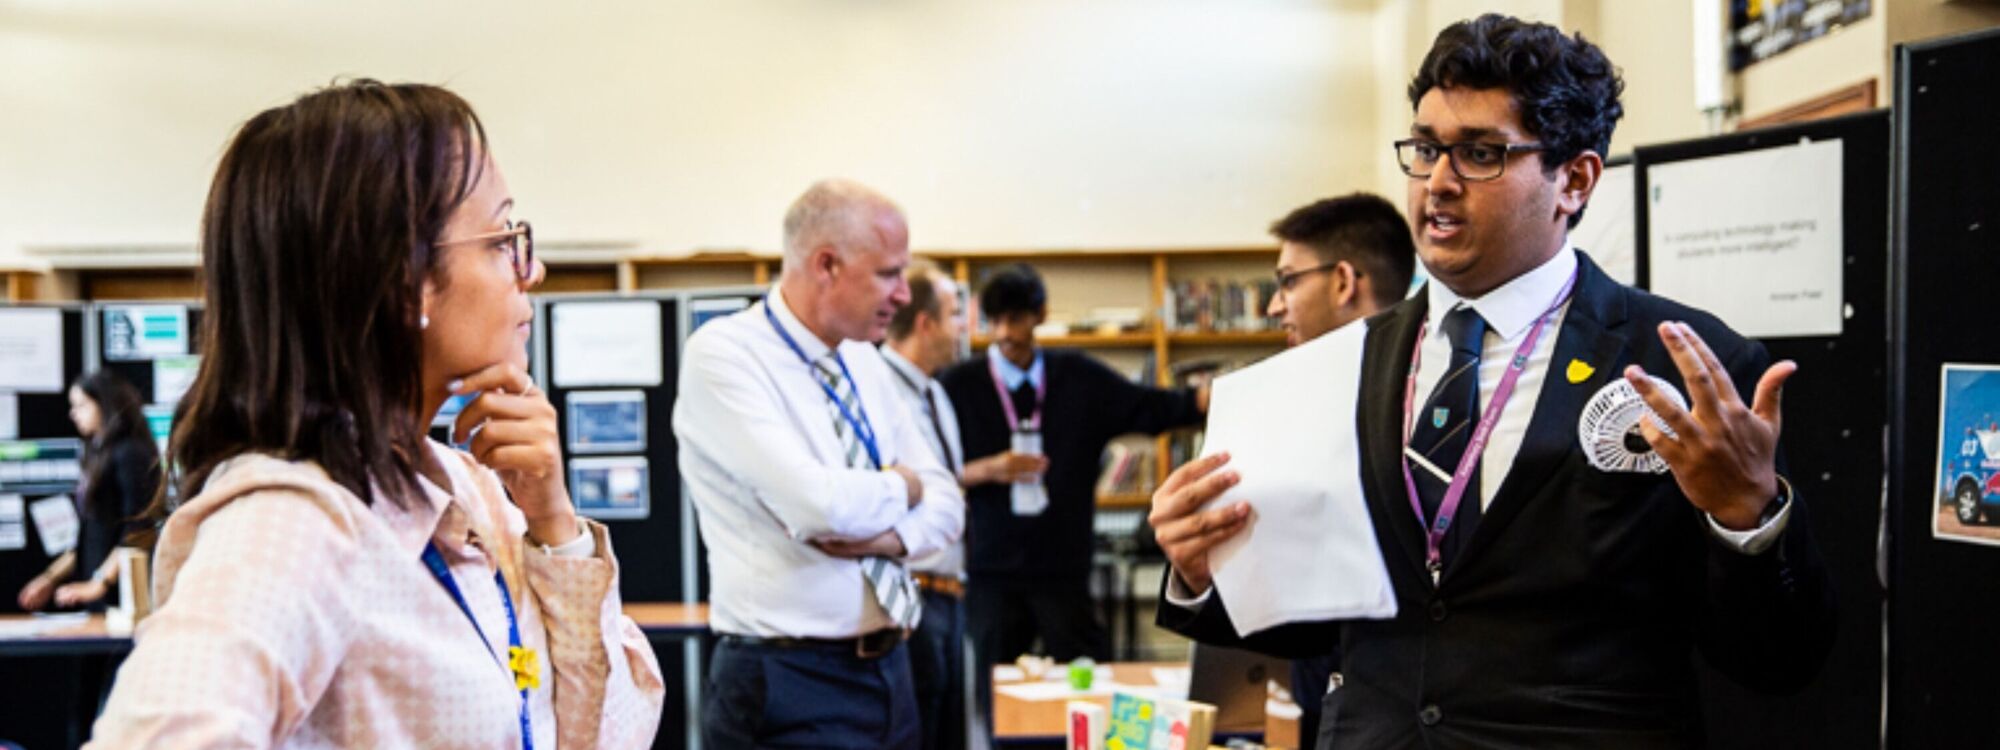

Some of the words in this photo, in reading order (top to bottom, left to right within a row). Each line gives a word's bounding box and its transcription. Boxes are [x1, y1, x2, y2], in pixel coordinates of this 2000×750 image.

[1675, 229, 1721, 242] computing
[1724, 222, 1776, 238] technology
[1779, 218, 1817, 233] making
[1677, 246, 1715, 258] students
[1719, 245, 1742, 255] more
